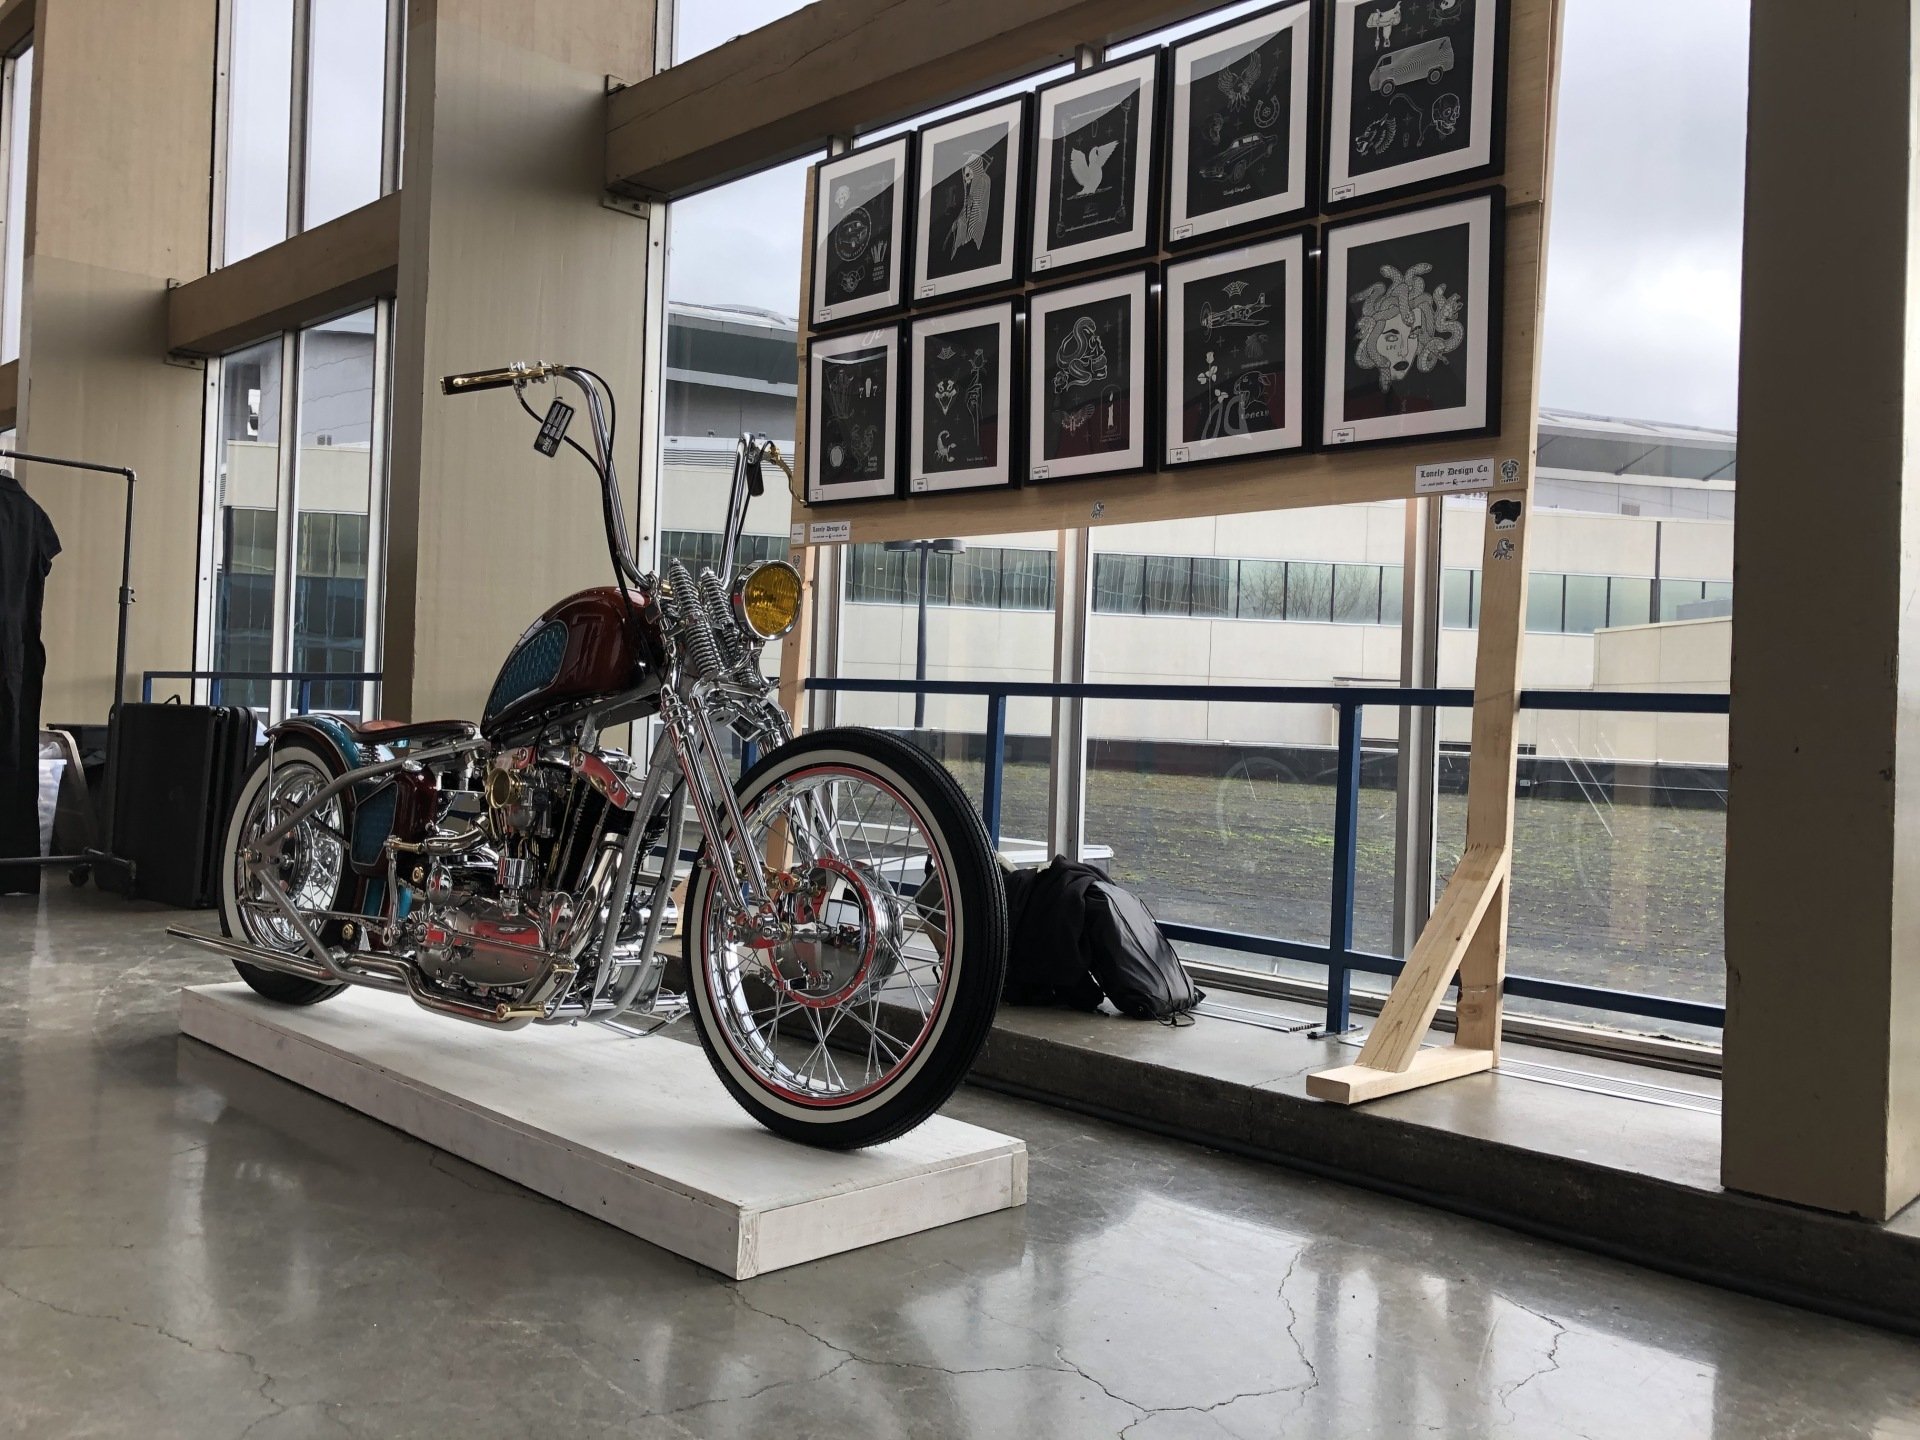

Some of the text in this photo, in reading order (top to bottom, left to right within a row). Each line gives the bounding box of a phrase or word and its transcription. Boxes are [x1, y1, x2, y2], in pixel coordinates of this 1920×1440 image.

[1420, 464, 1490, 479] Lonely Design Co.
